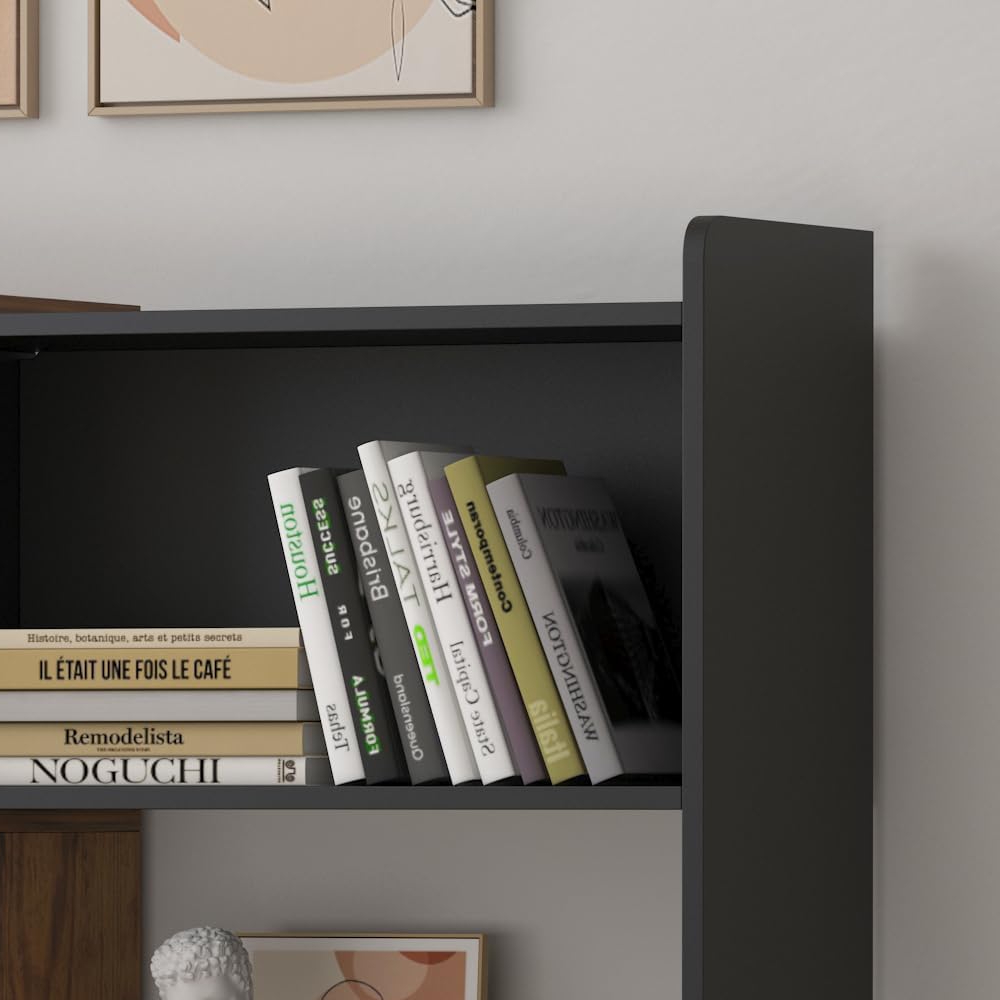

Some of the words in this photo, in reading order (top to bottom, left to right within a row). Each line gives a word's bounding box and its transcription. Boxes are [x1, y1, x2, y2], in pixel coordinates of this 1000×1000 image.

[27, 633, 72, 645] Histoire,
[75, 632, 129, 645] botanique,
[132, 633, 154, 642] arts
[158, 633, 168, 642] et
[170, 632, 201, 645] petits
[204, 633, 242, 642] secrets
[39, 660, 52, 680] IL
[56, 656, 97, 680] ÉTAIT
[101, 660, 131, 680] UNE
[135, 659, 167, 679] FOIS
[172, 659, 189, 679] LE
[193, 655, 232, 679] CAFÉ
[64, 728, 184, 745] Remodelista
[30, 758, 221, 784] NOGUCHI
